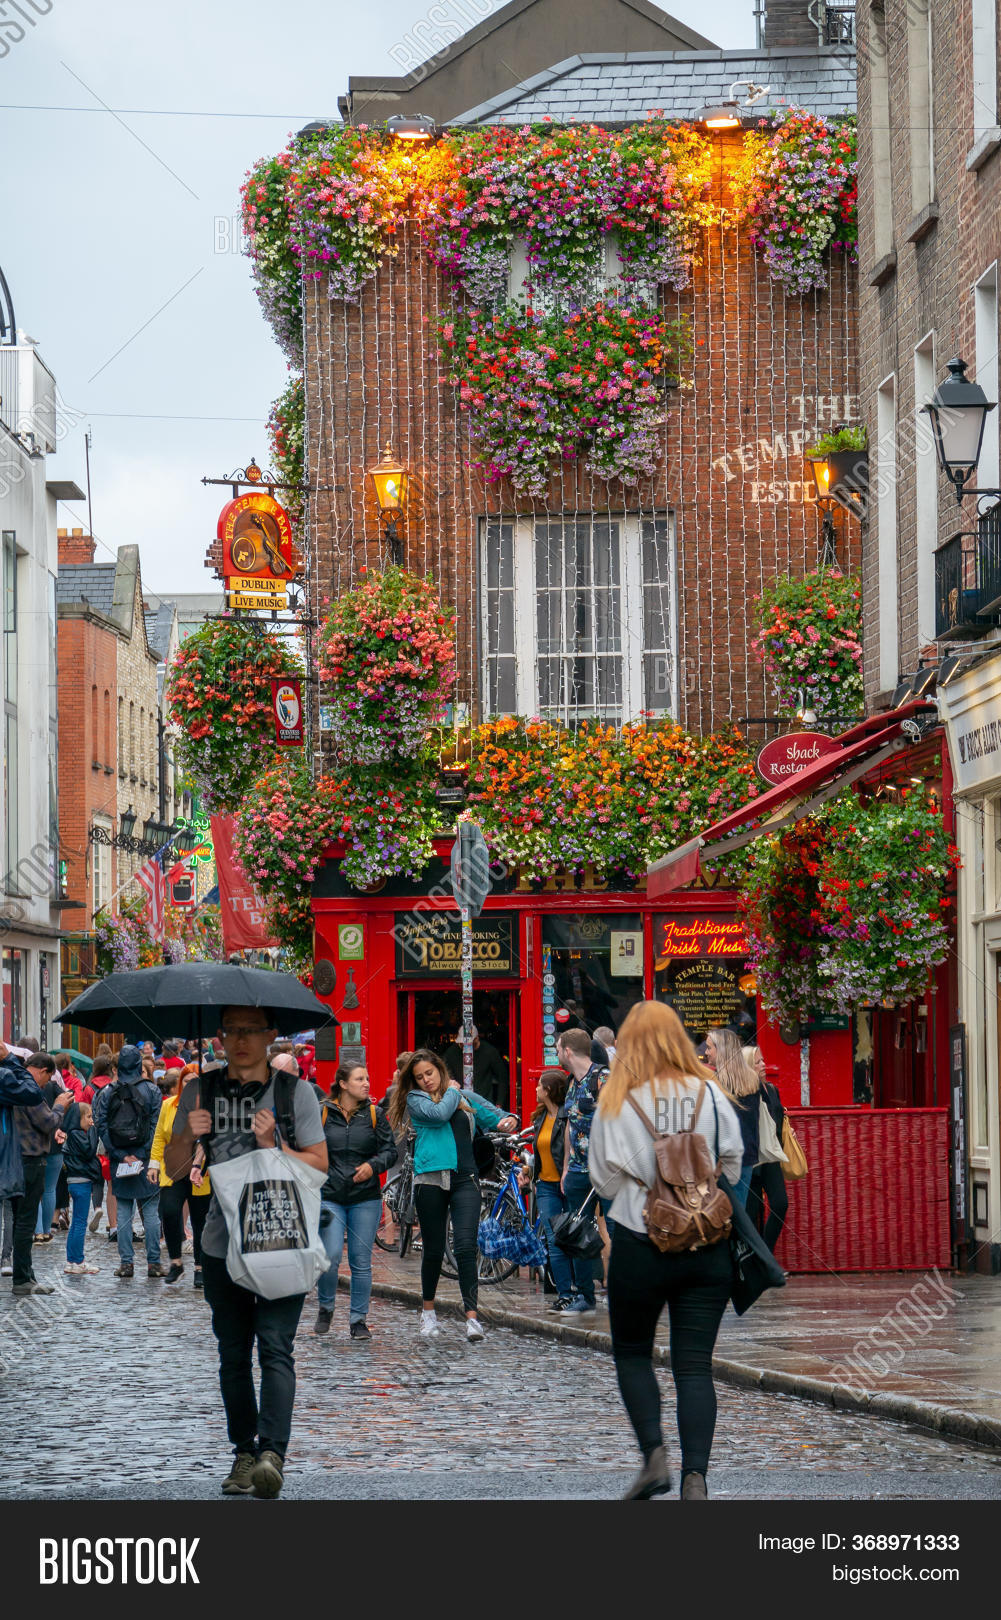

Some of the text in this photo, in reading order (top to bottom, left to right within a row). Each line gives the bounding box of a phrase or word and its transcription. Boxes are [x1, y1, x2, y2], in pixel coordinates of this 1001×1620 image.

[792, 394, 861, 421] THE
[225, 511, 237, 542] THE
[276, 513, 290, 545] BAR
[241, 579, 276, 590] DUBLIN
[235, 596, 284, 608] LIVE MUSIC
[786, 741, 821, 761] Shack
[471, 932, 500, 940] OKING
[661, 937, 744, 955] Irish Musi
[431, 961, 462, 969] Alway
[481, 960, 508, 968] Stock
[675, 964, 735, 981] TEMPLE BAR
[254, 1189, 287, 1201] THIS IS
[248, 1200, 295, 1211] NOT JUST
[247, 1209, 299, 1222] ANY FOOD
[256, 1219, 292, 1231] THIS IS
[247, 1229, 301, 1241] M&S FOOD
